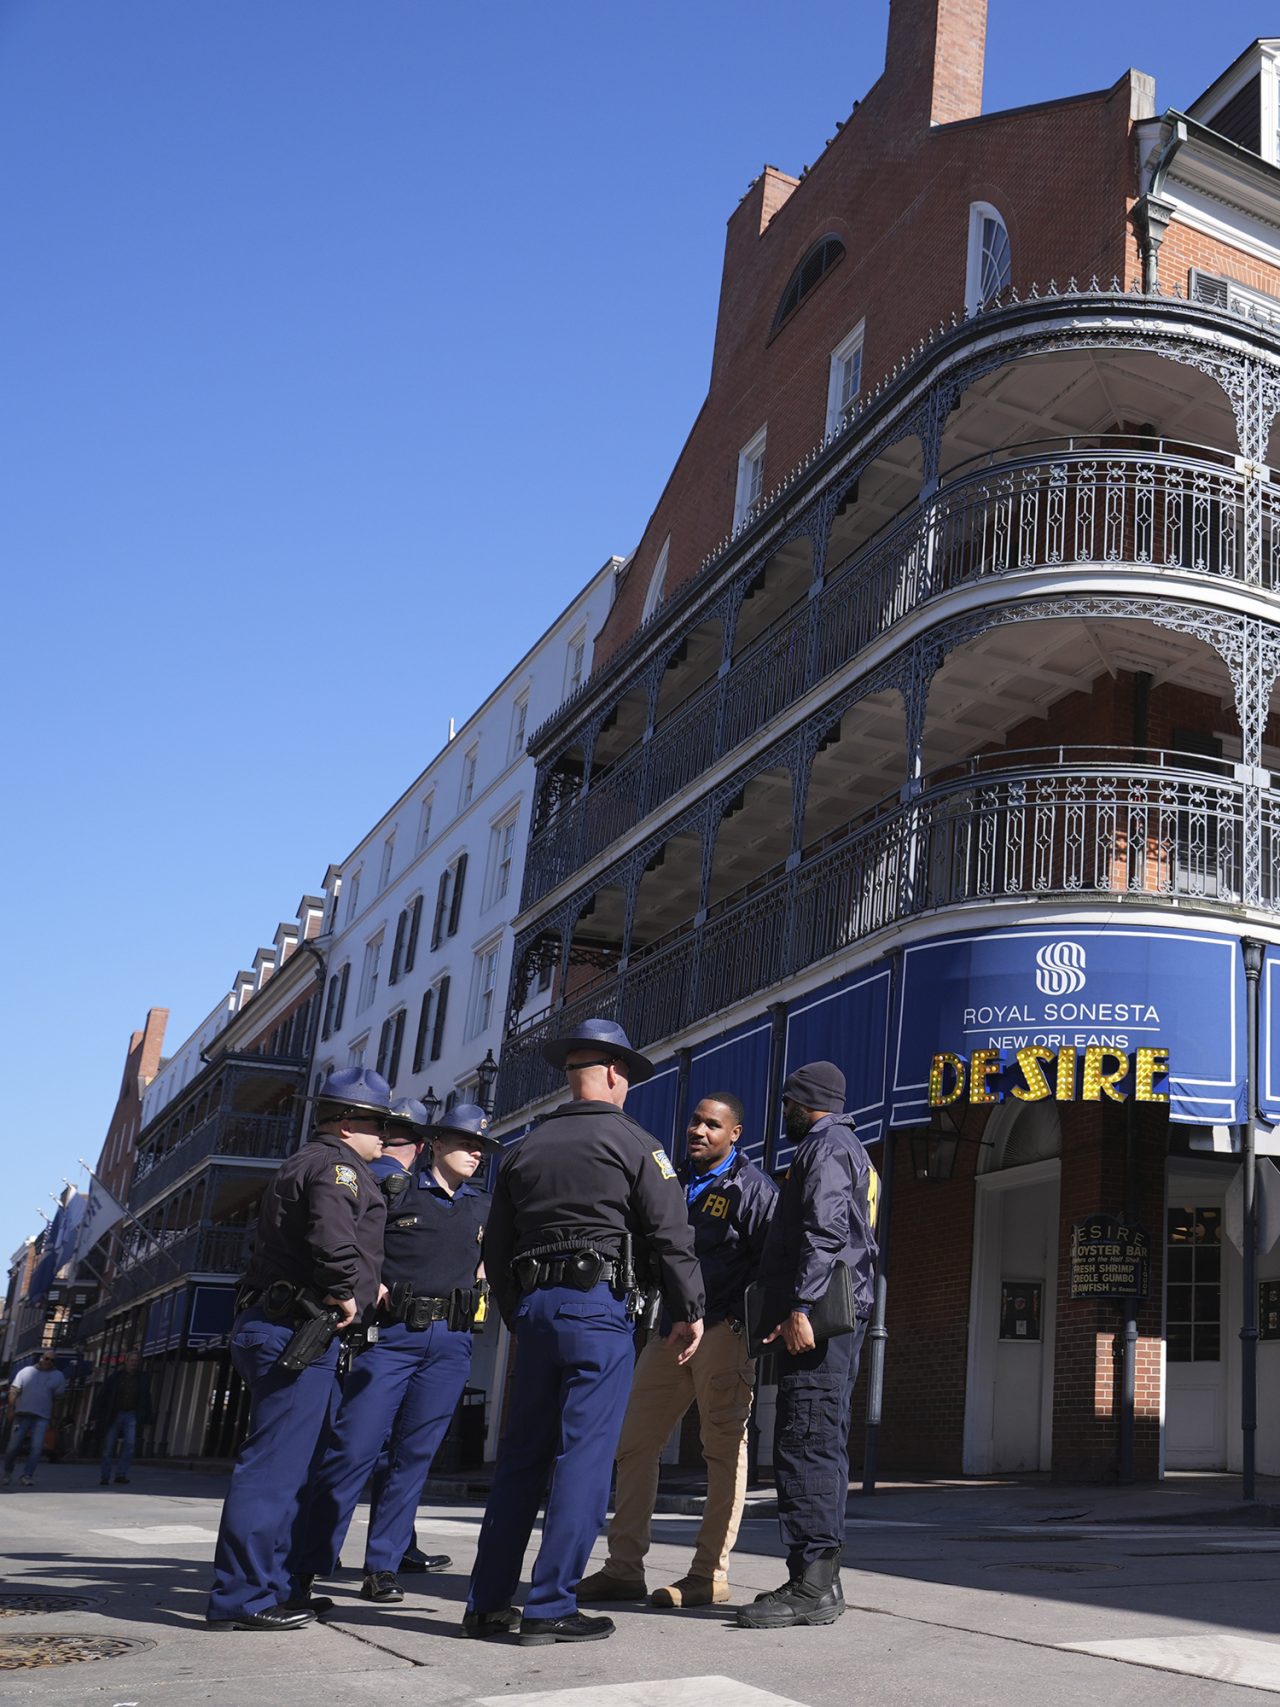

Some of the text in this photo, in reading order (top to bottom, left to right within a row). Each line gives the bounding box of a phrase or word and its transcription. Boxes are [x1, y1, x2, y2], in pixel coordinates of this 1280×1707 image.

[963, 1003, 1160, 1025] ROYAL SONESTA
[988, 1034, 1129, 1049] NEW ORLEANS
[928, 1046, 1171, 1107] DESIRE
[701, 1194, 731, 1220] FBI
[1077, 1245, 1148, 1257] OYSTER BAR
[1073, 1264, 1135, 1274] FRESH SHRIMP
[1102, 1273, 1135, 1284] GUMBO
